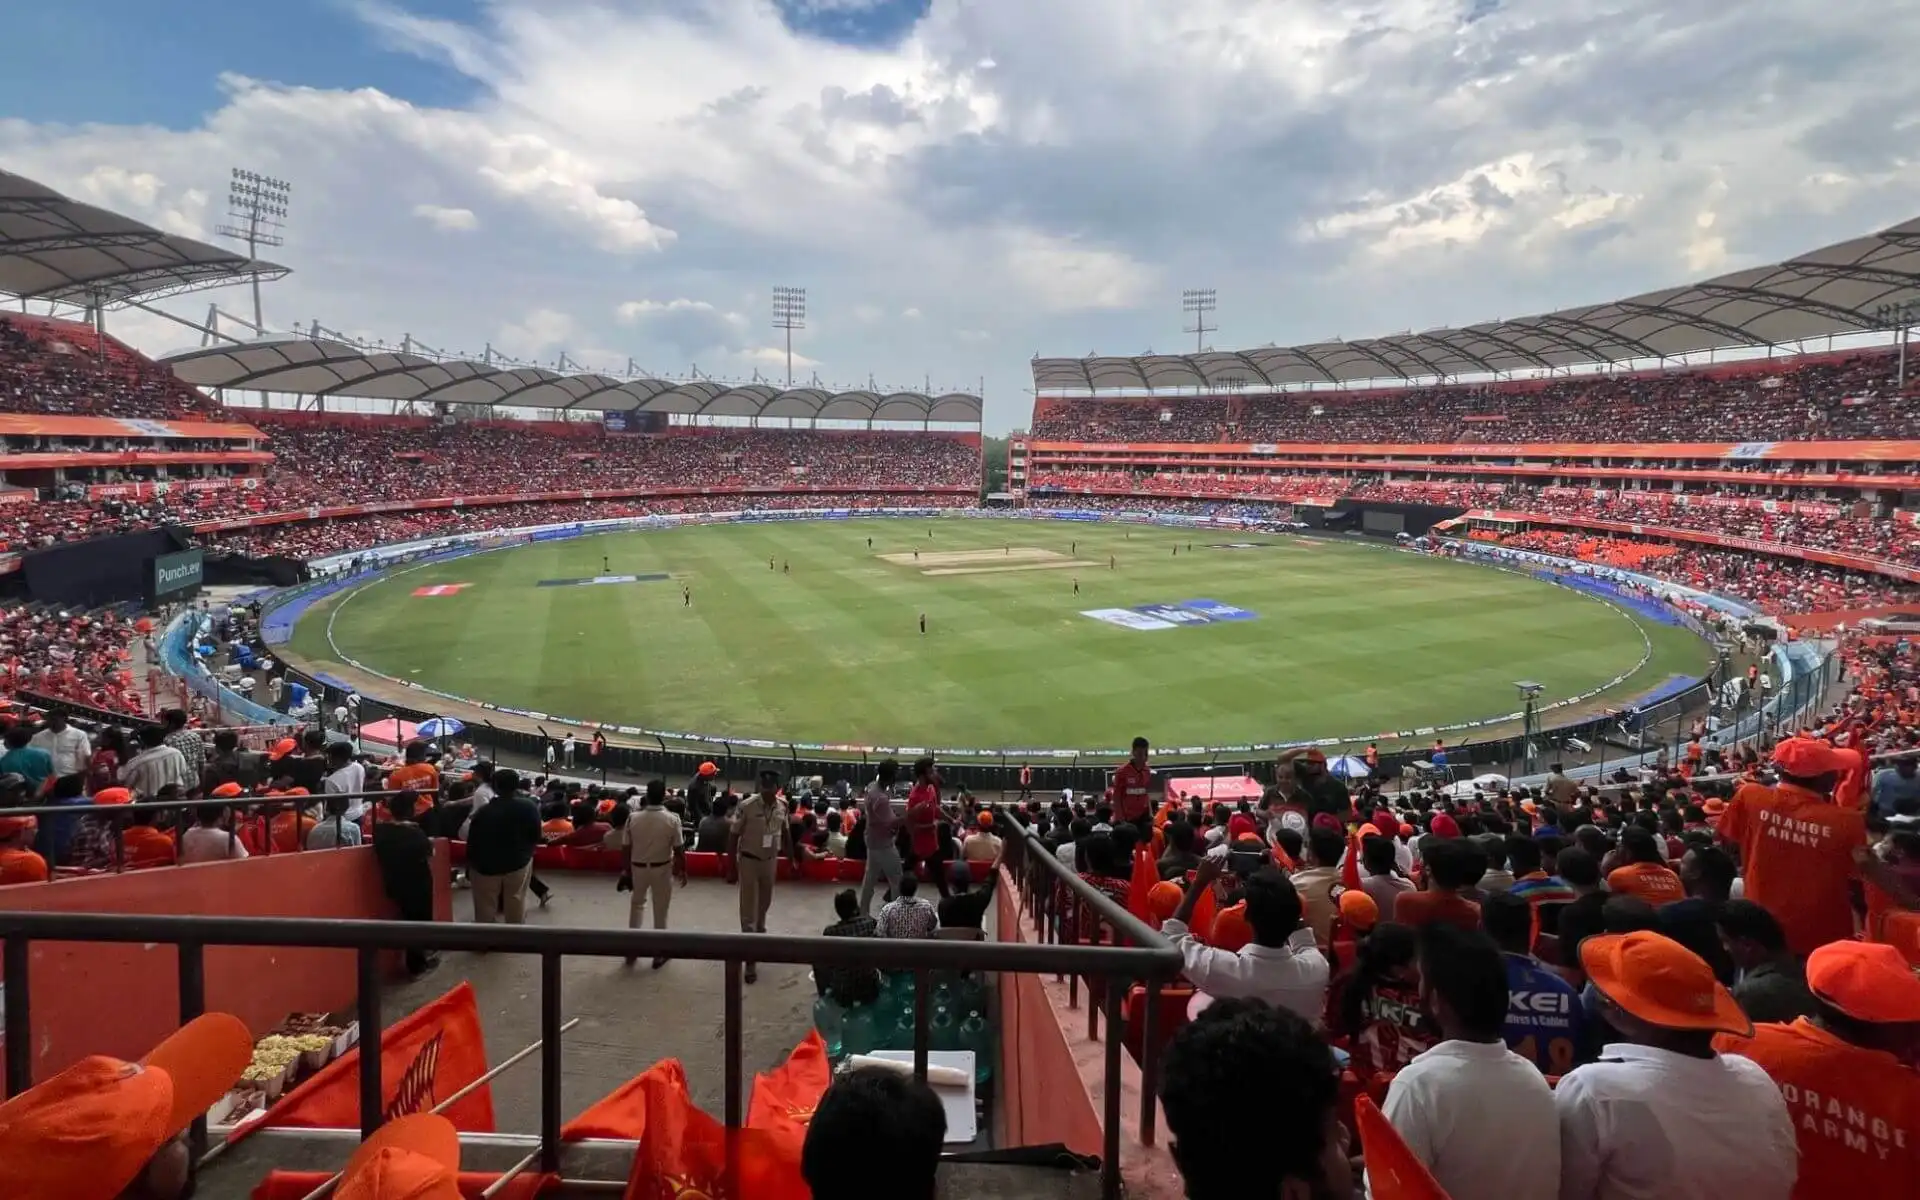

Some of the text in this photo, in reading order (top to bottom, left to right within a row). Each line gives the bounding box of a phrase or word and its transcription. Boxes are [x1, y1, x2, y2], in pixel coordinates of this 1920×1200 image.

[159, 562, 200, 584] Punch.ev
[1760, 809, 1832, 838] ORANGE
[1767, 826, 1819, 849] ARMY
[1508, 990, 1569, 1014] KEI
[1782, 1083, 1906, 1148] ORANGE
[1803, 1113, 1889, 1160] ARMY
